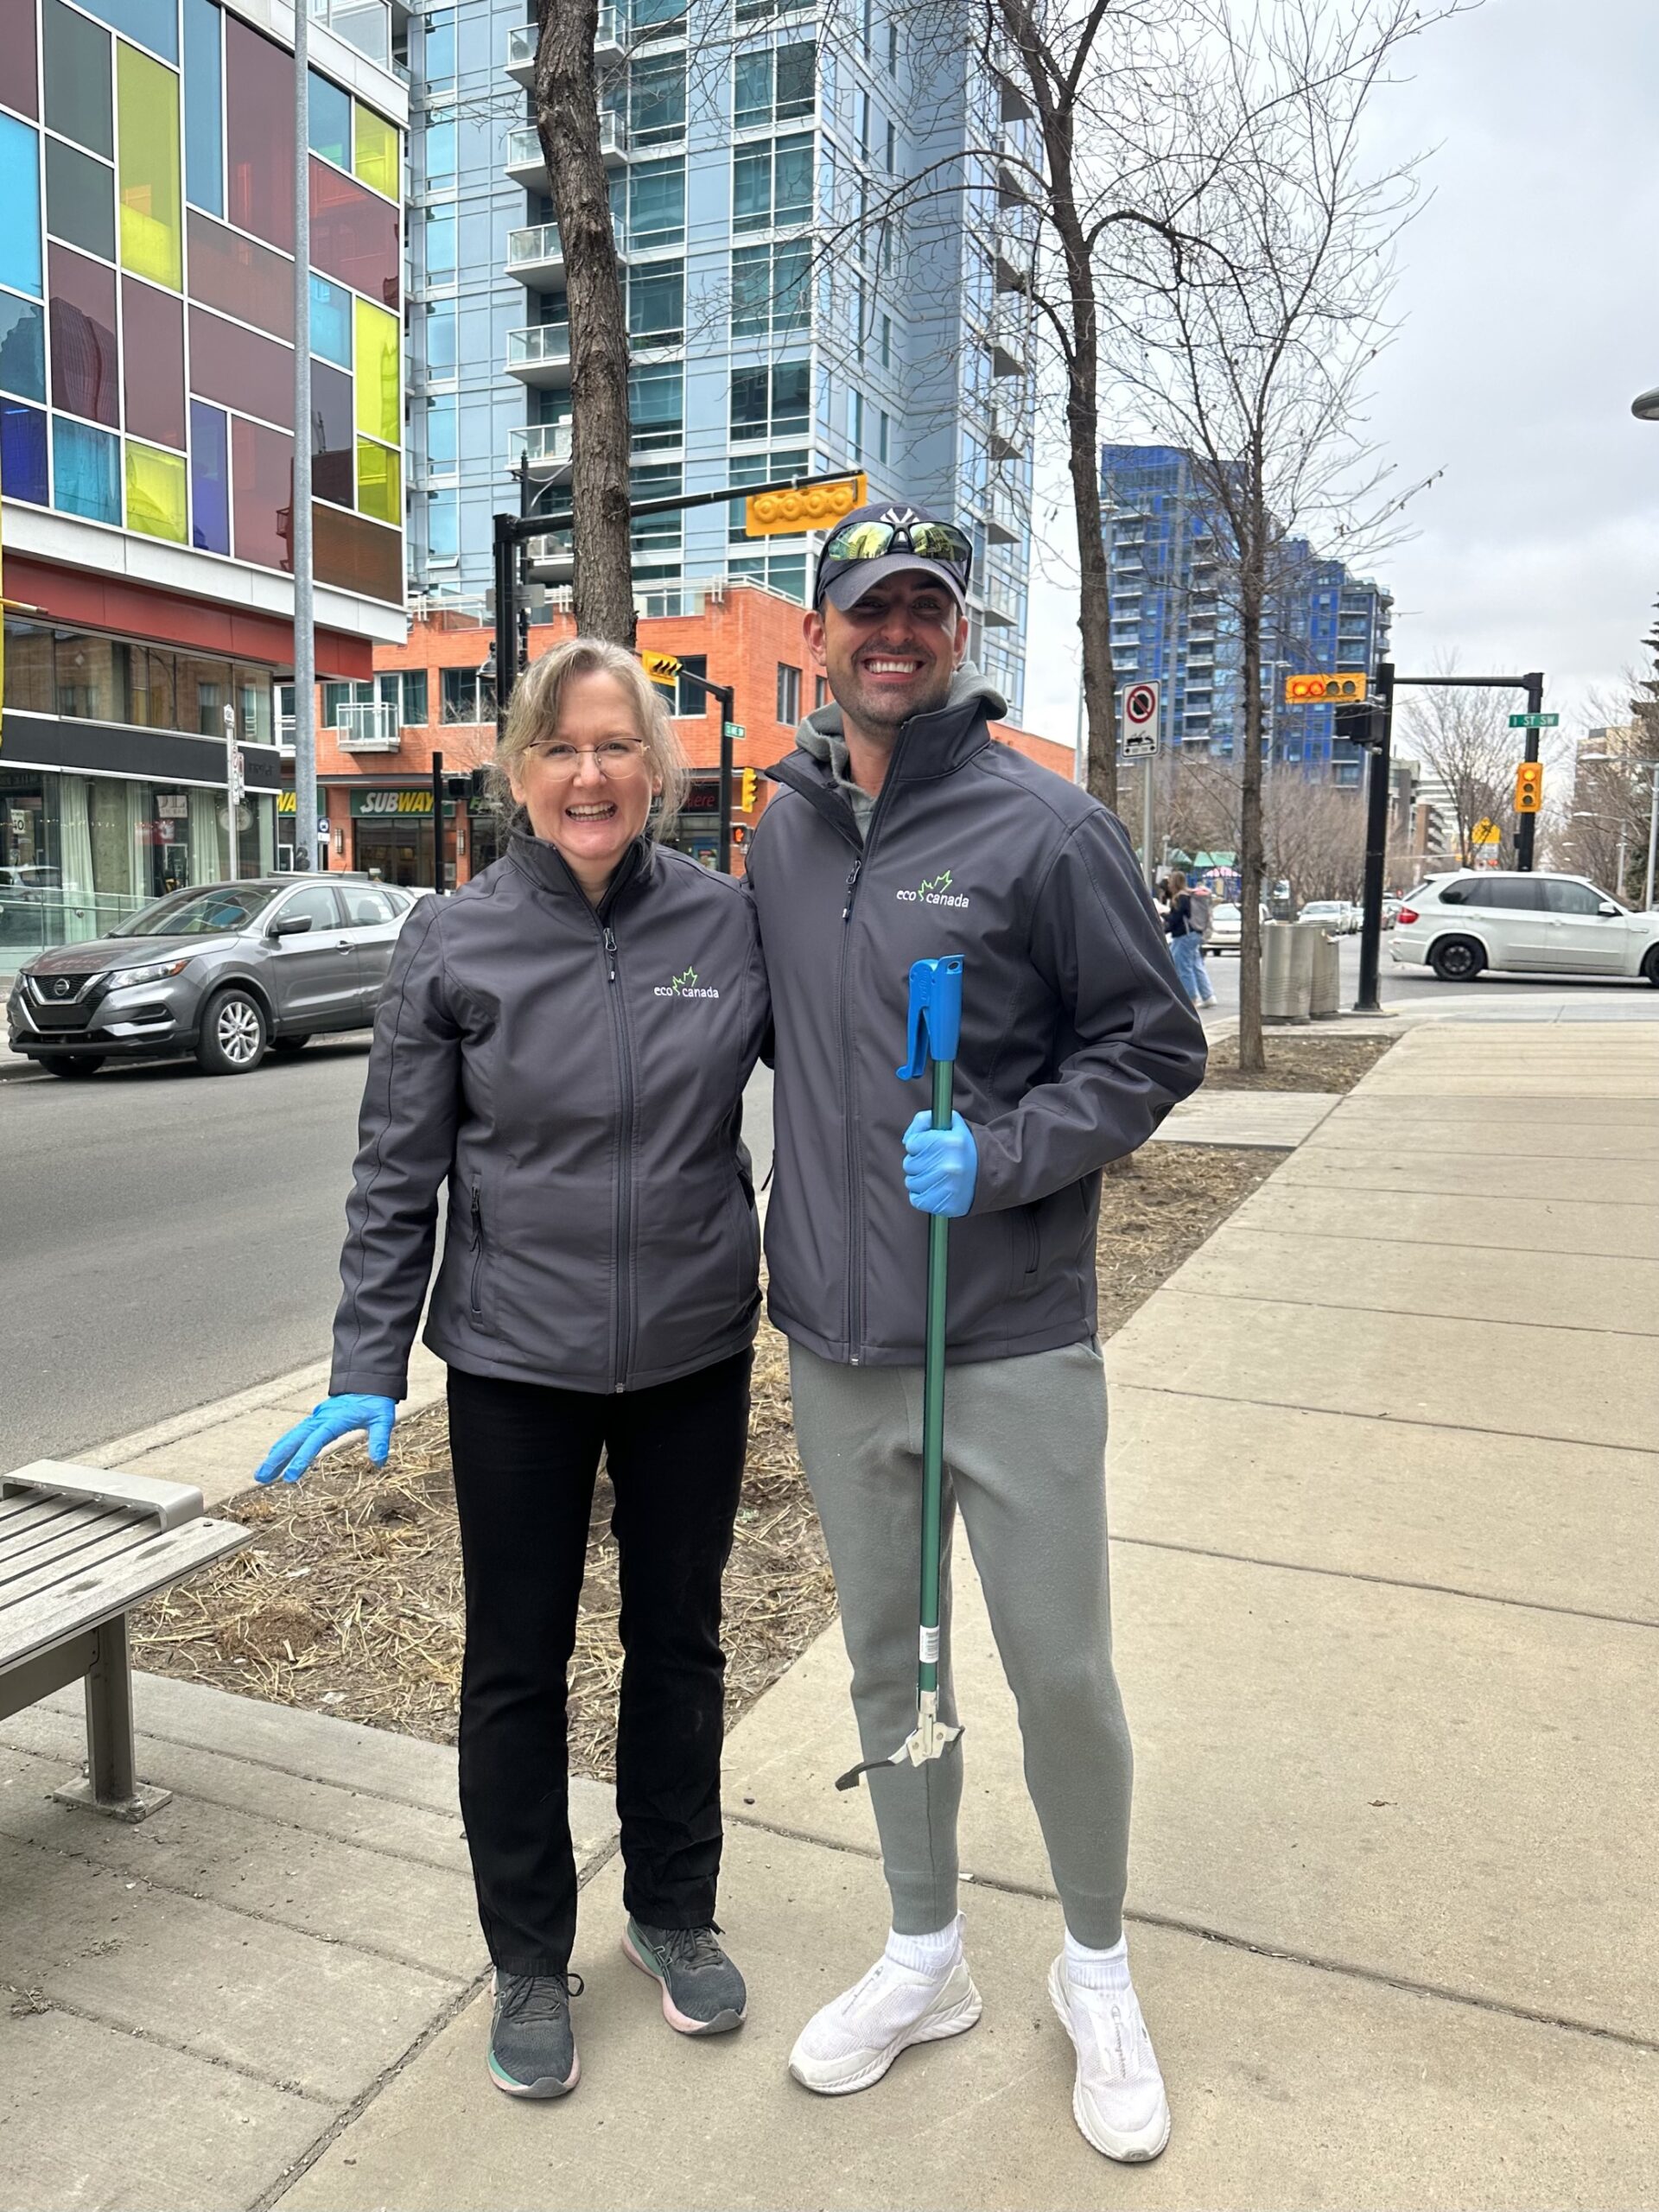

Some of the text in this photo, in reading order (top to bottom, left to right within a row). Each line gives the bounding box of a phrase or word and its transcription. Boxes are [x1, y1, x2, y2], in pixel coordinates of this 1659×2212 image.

[1523, 715, 1535, 726] ST
[1540, 715, 1555, 726] SW
[359, 791, 434, 813] SUBWAY
[896, 890, 969, 908] eco canada
[654, 986, 720, 998] eco canada
